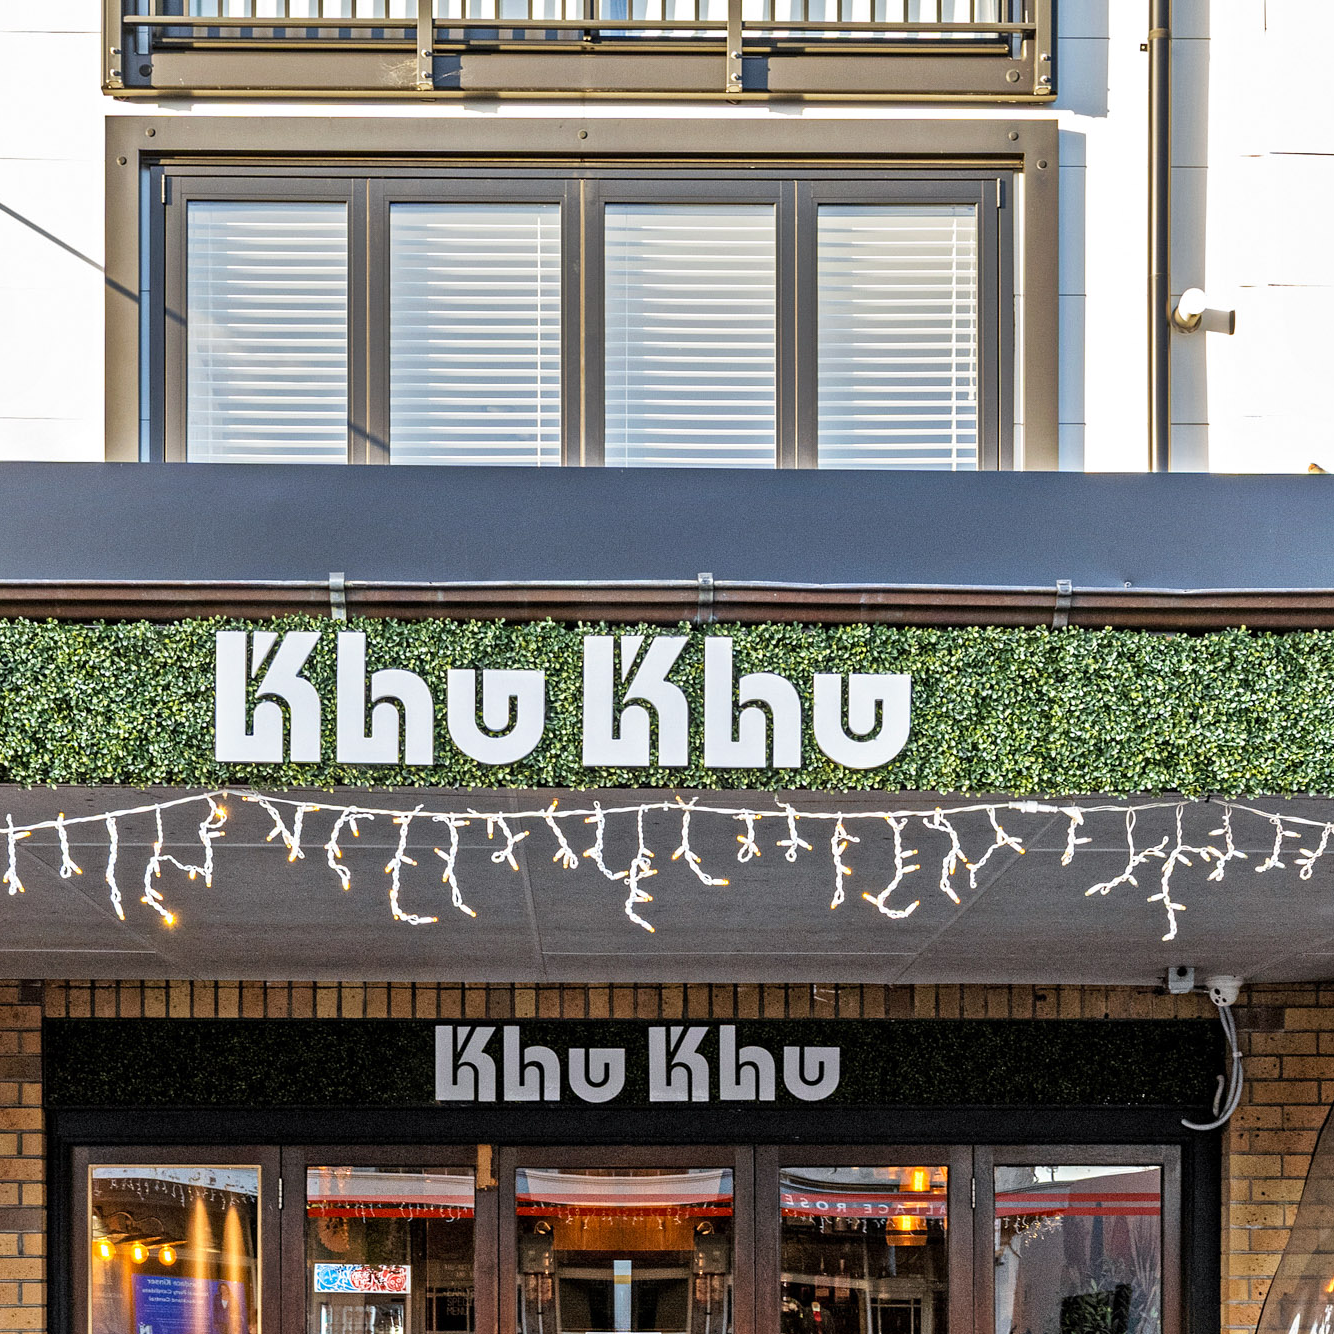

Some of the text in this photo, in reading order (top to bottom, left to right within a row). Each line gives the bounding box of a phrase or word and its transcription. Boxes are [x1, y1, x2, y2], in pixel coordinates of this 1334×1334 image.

[216, 631, 911, 768] Khu Khu
[435, 1025, 841, 1103] Khu Khu
